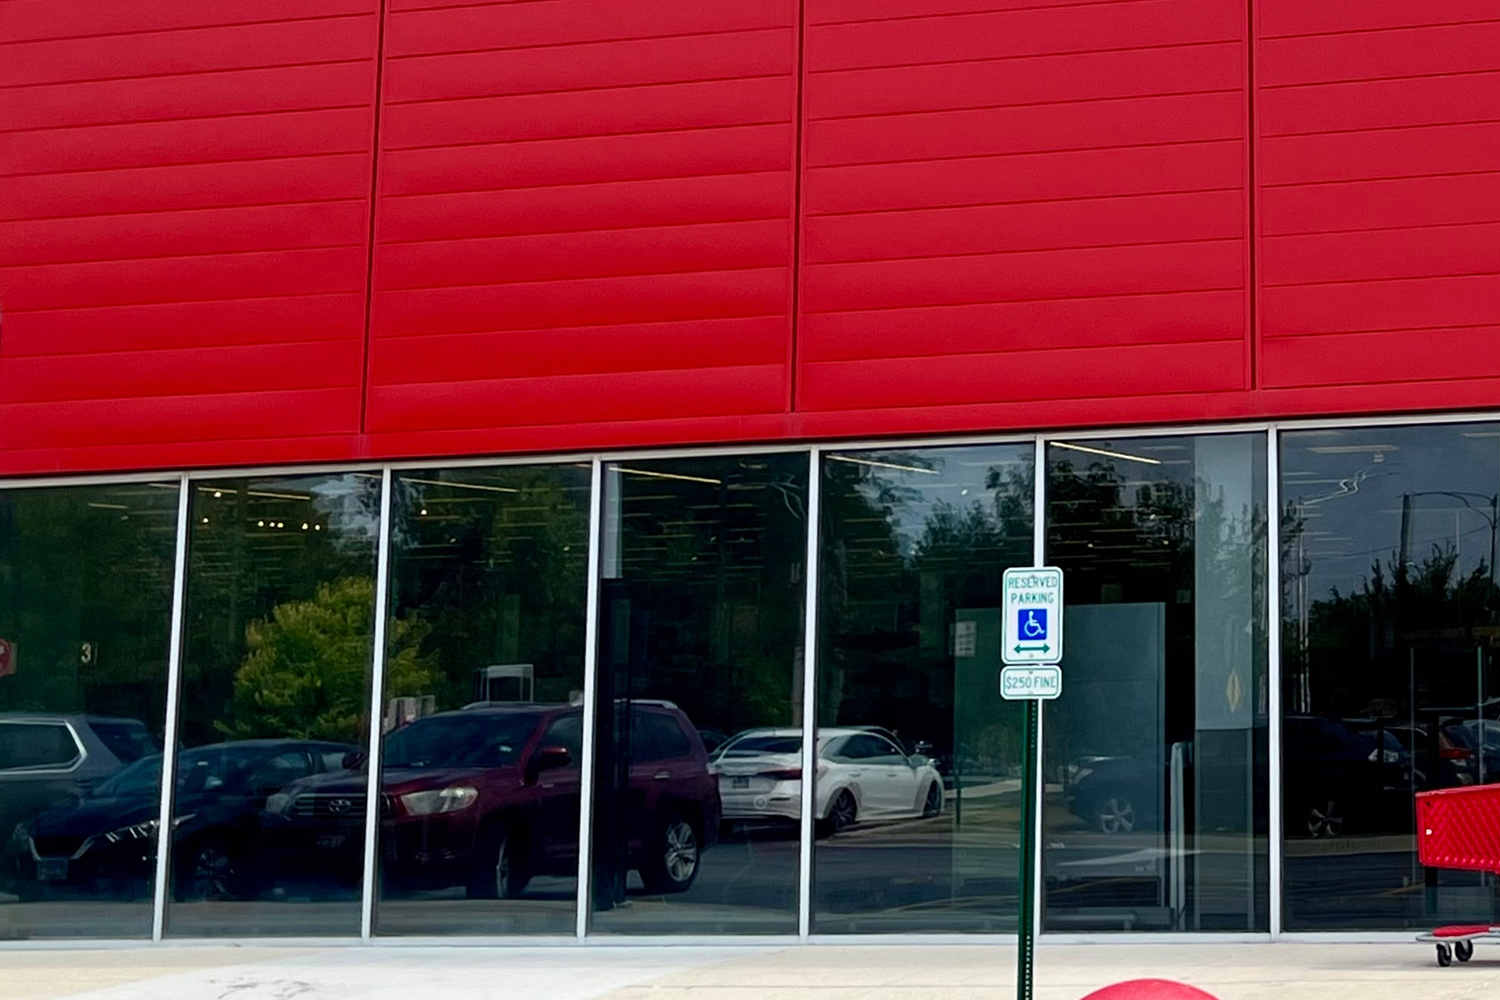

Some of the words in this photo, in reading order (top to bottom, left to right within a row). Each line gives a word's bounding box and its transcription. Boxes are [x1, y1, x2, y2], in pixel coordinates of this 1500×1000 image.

[1008, 576, 1057, 588] RESERVED
[1010, 592, 1055, 604] PARKING
[1006, 676, 1031, 690] $250
[1033, 676, 1057, 689] FINE
